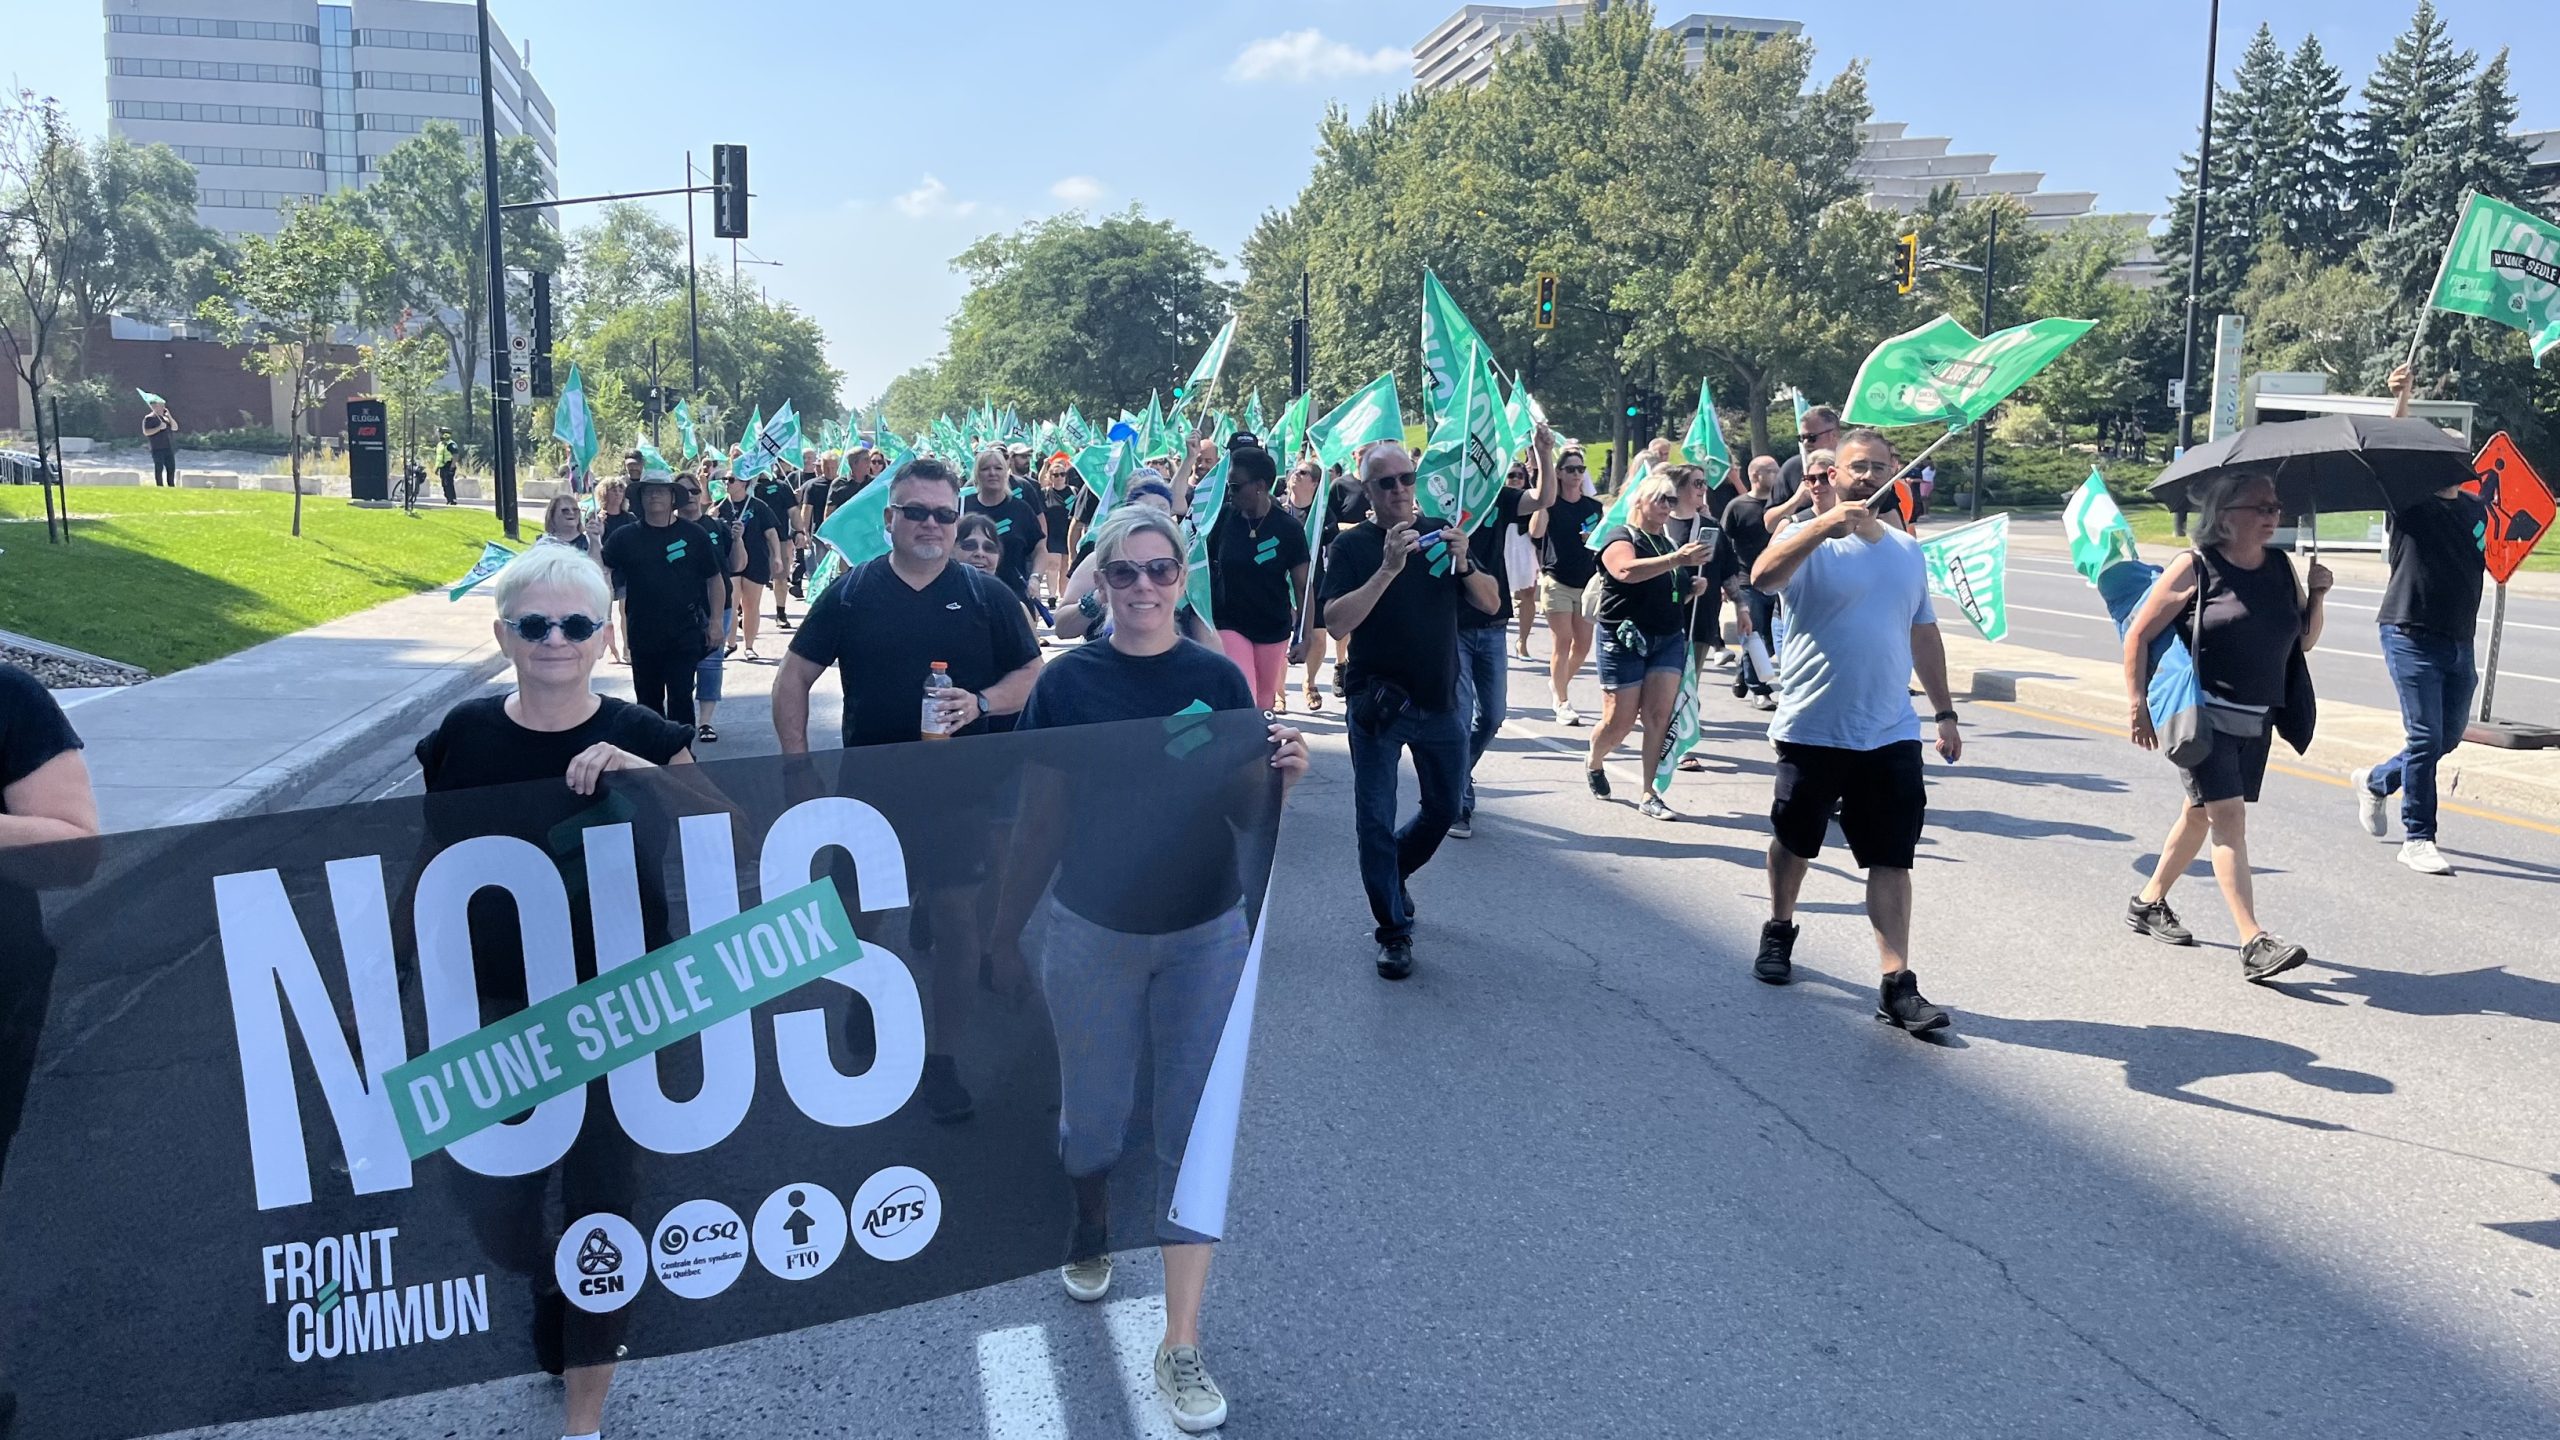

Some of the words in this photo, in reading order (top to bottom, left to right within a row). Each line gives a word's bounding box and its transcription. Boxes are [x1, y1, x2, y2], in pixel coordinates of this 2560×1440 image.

[2494, 252, 2527, 269] D'UNE
[2525, 260, 2558, 282] SEULE
[213, 797, 926, 1210] NOUS
[408, 1024, 562, 1135] D'UNE
[567, 955, 713, 1061] SEULE
[714, 900, 838, 993] VOIX
[861, 1200, 924, 1230] APTS
[692, 1221, 739, 1242] CSQ
[262, 1227, 399, 1304] FRONT
[661, 1258, 691, 1270] Centrale
[693, 1257, 706, 1265] des
[708, 1251, 742, 1264] syndicats
[661, 1271, 671, 1280] du
[673, 1268, 701, 1279] Québec
[786, 1250, 819, 1270] FTQ
[579, 1275, 624, 1296] CSN
[288, 1274, 490, 1363] COMMUN
